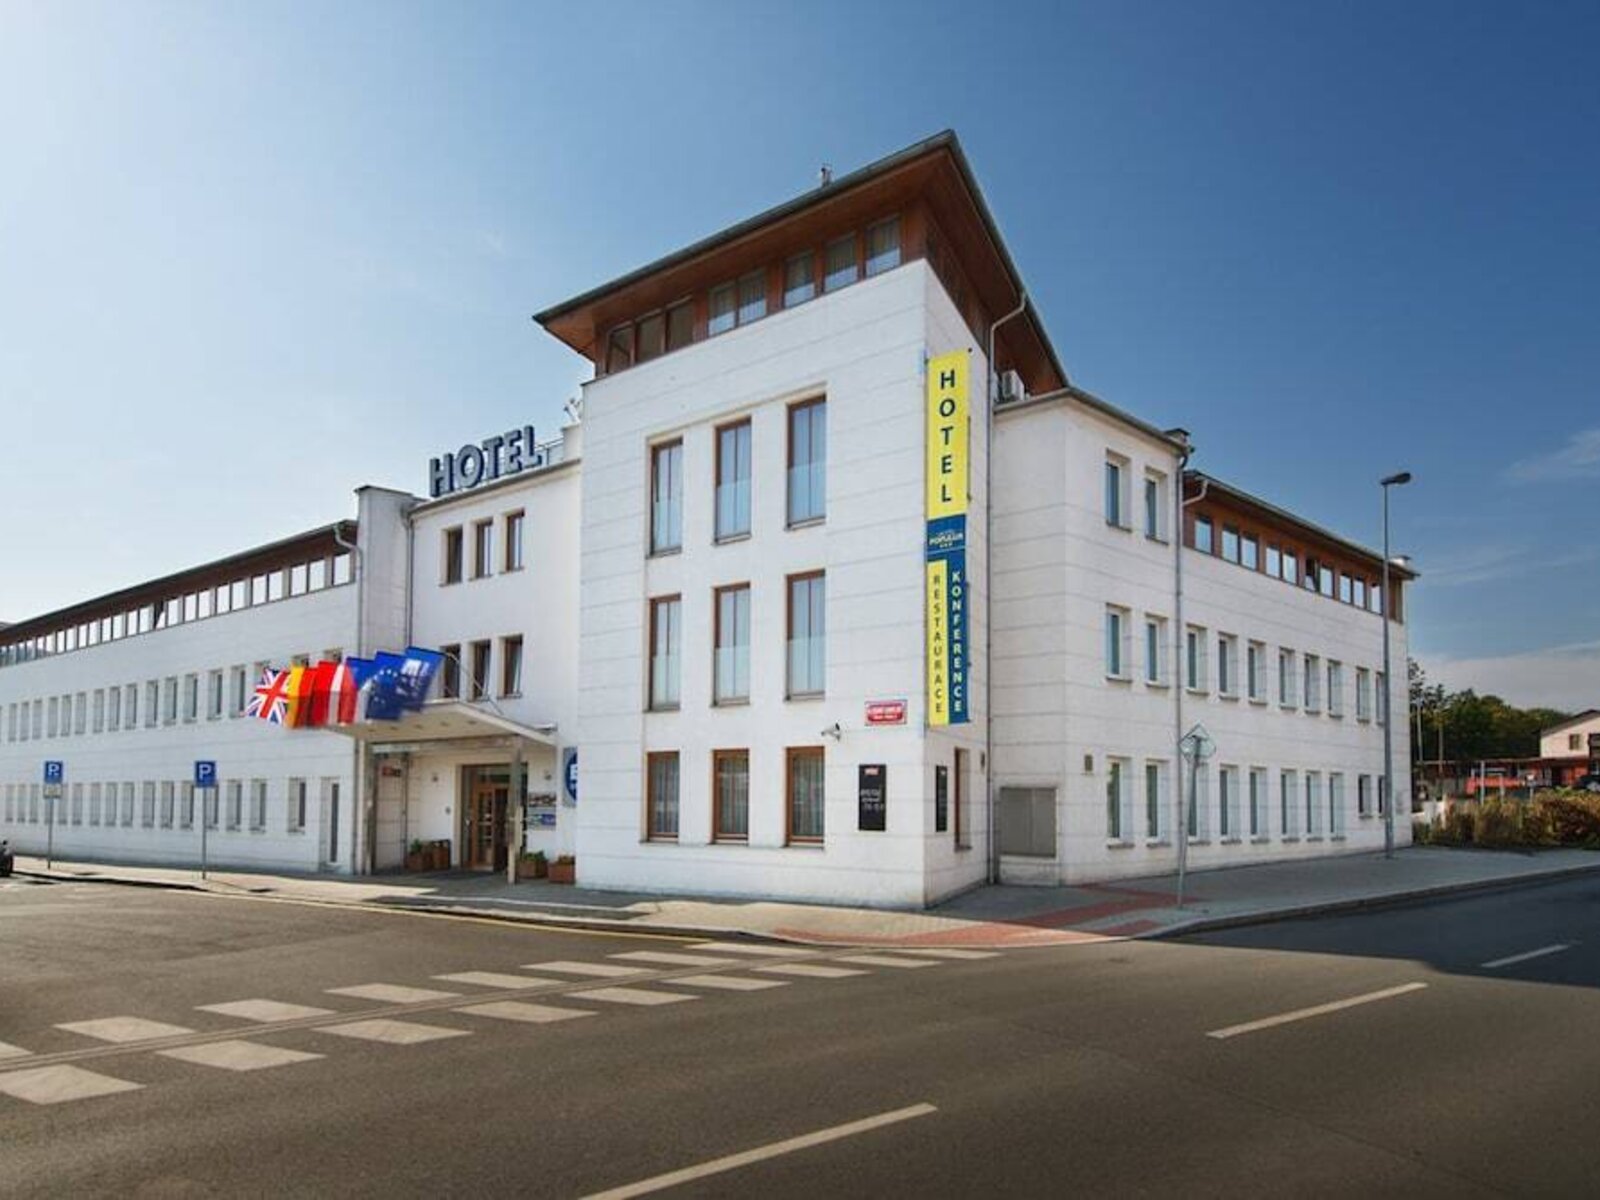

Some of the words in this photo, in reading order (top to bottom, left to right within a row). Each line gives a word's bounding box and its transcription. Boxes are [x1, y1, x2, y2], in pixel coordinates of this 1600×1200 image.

[429, 425, 543, 498] HOTEL
[940, 369, 955, 502] HOTEL
[933, 574, 942, 713] RESTAURACE
[951, 571, 963, 713] KONFERENCE
[199, 763, 212, 780] P
